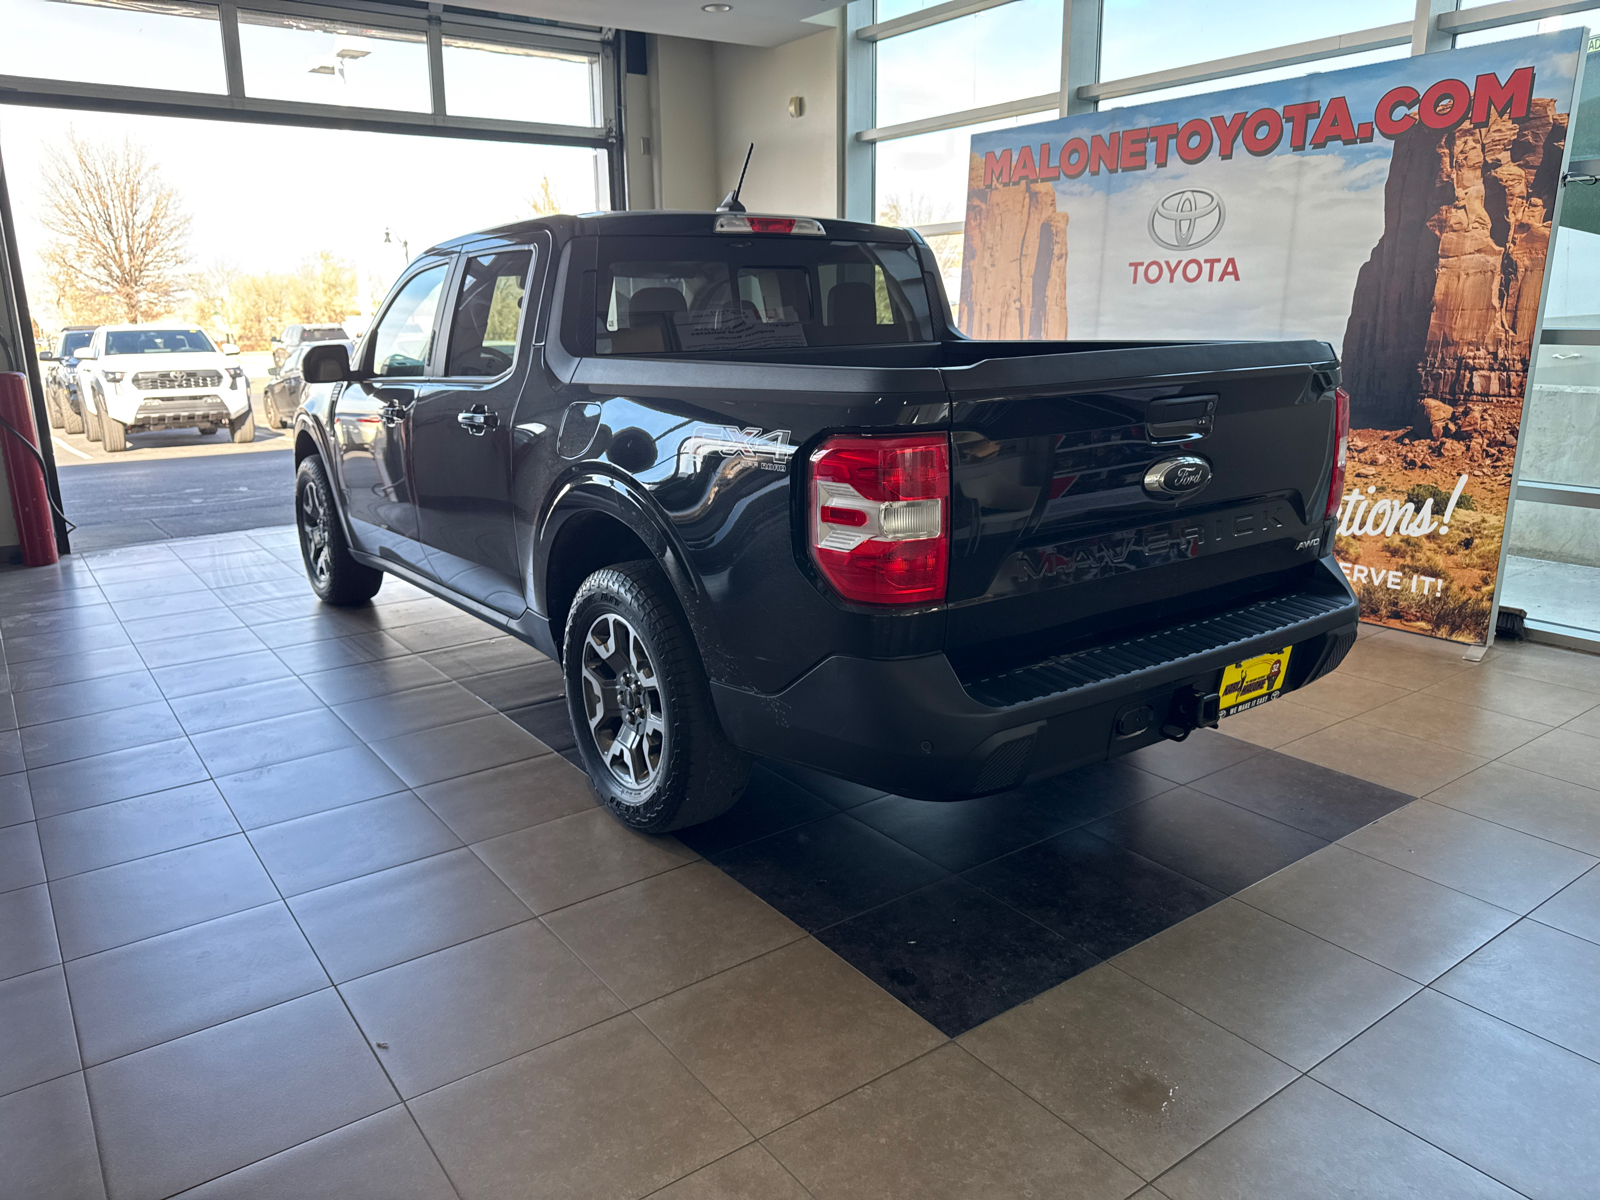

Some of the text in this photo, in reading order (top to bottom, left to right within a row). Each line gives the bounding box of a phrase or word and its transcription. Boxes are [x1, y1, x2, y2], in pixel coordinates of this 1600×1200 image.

[983, 66, 1536, 187] MALONETOYOTA.COM
[1128, 256, 1240, 284] TOYOTA
[692, 425, 791, 464] FX4
[760, 462, 786, 472] ROAD
[1174, 466, 1202, 486] Ford
[1336, 474, 1468, 537] tions!
[1016, 507, 1284, 583] MAVERICK
[1295, 537, 1320, 551] AWD
[1339, 561, 1443, 597] ERVE IT!
